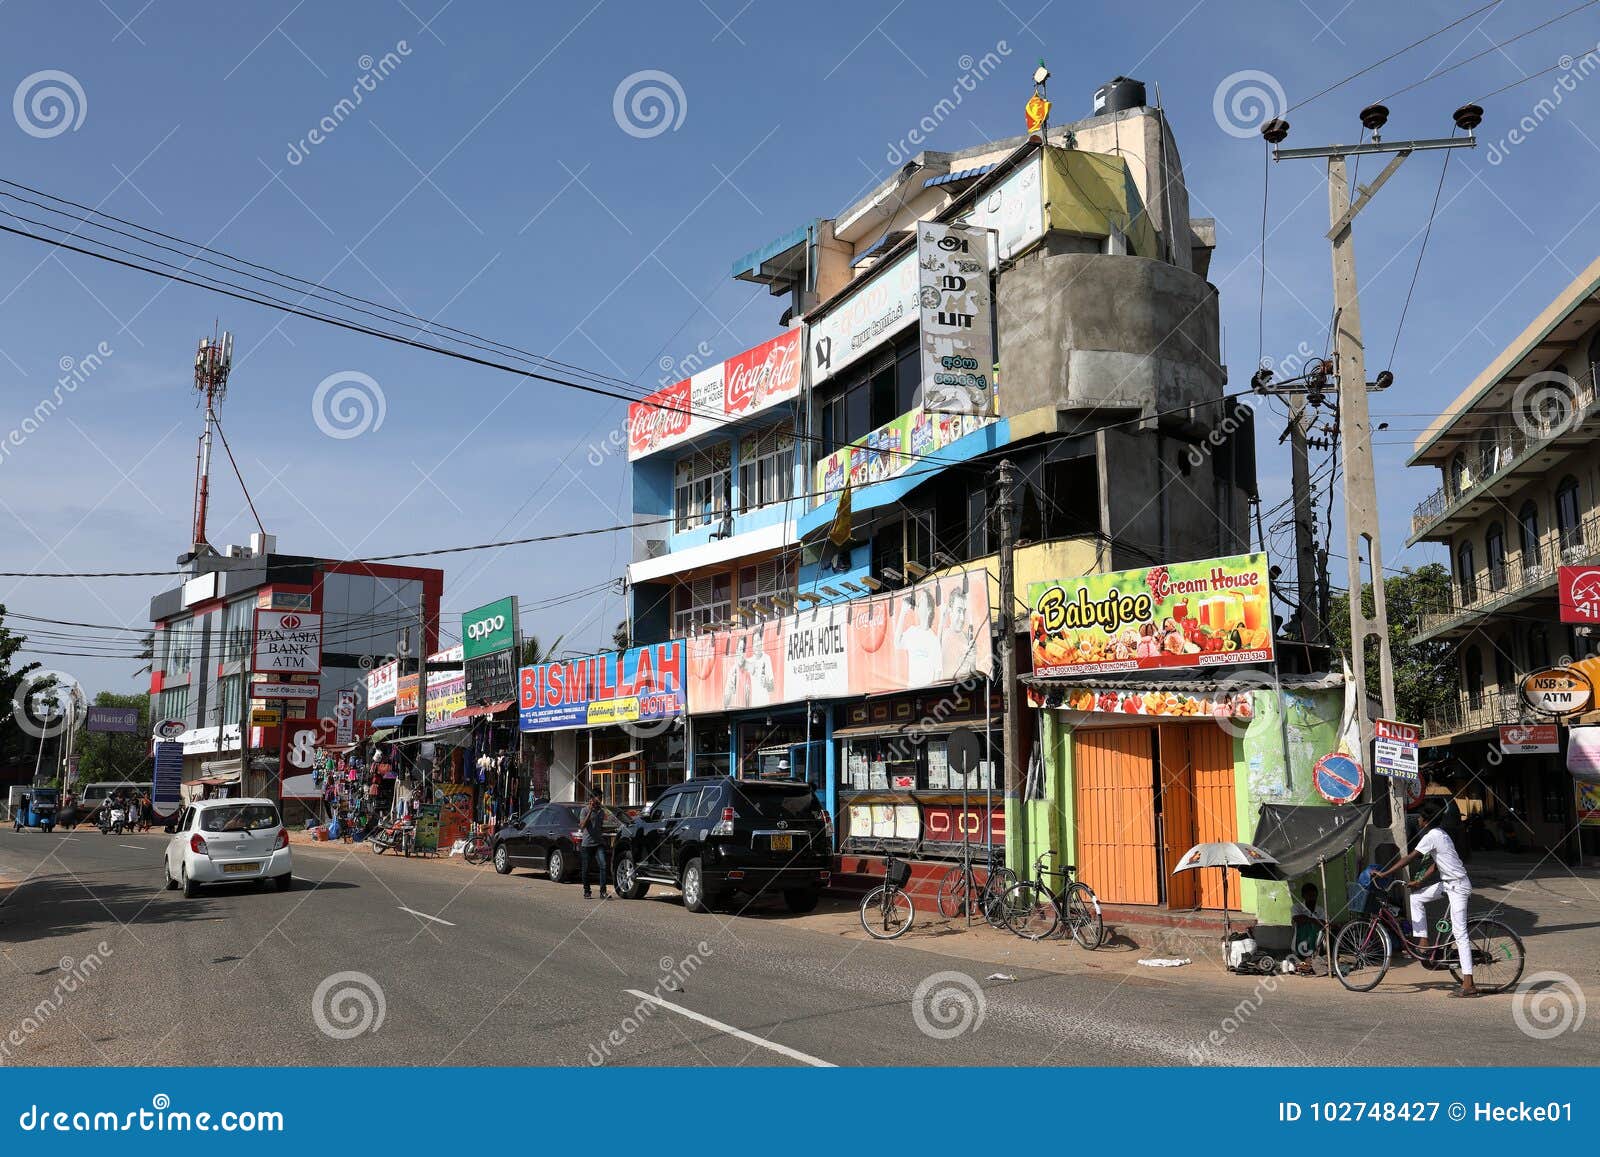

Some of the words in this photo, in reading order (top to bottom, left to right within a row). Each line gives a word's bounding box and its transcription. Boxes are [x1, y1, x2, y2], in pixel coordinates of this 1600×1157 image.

[704, 381, 719, 394] HOTEL
[708, 388, 723, 401] HOUSE
[1158, 572, 1208, 597] Cream
[1210, 567, 1258, 591] House
[1037, 587, 1151, 634] Babujee
[467, 615, 505, 641] oppo
[259, 631, 284, 641] PAN
[288, 632, 318, 643] ASIA
[787, 630, 814, 661] ARAFA
[818, 625, 844, 656] HOTEL
[269, 643, 309, 655] BANK
[273, 657, 304, 667] ATM
[519, 642, 681, 710] BISMILLAH
[1534, 678, 1557, 689] NSB
[1542, 693, 1572, 702] ATM
[640, 694, 681, 715] HOTEL
[91, 714, 122, 723] Allianz
[1378, 721, 1416, 740] HND
